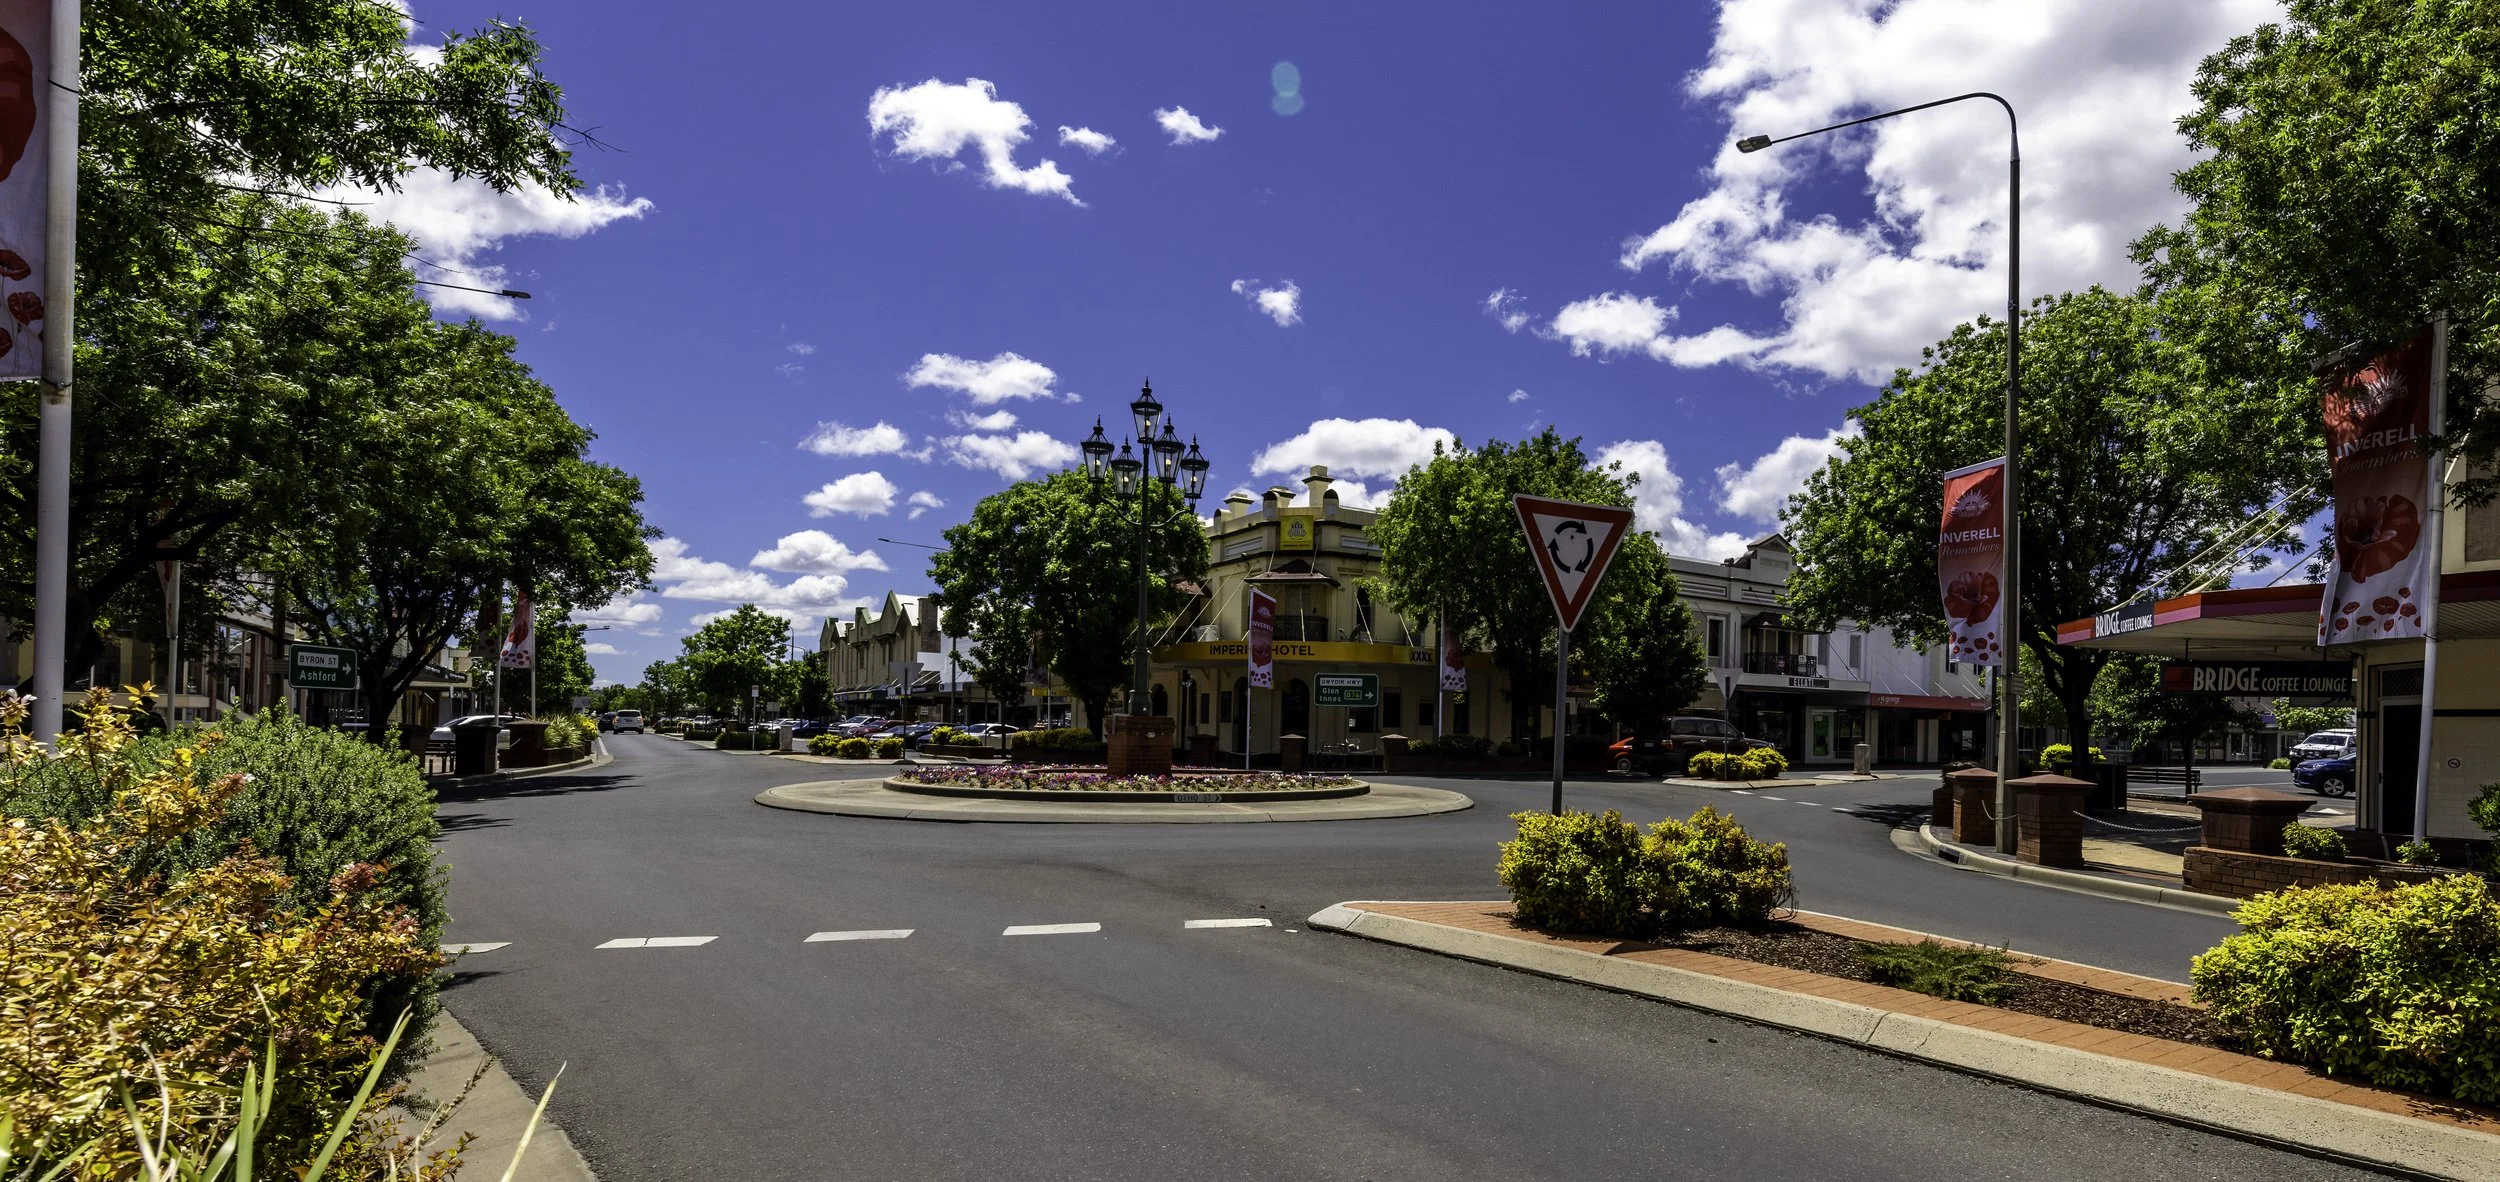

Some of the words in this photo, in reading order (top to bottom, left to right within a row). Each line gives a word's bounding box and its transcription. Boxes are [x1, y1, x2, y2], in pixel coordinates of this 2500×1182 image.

[2336, 424, 2421, 459] INVERELL
[1940, 527, 2000, 543] INVERELL
[1942, 541, 2000, 556] Remembers
[2095, 611, 2120, 638] BRIDGE
[2120, 618, 2134, 633] COFFEE
[2134, 614, 2153, 630] LOUNGE
[1209, 644, 1248, 656] IMPERI
[1272, 644, 1315, 656] HOTEL
[1409, 650, 1433, 663] XXXX
[300, 655, 325, 664] BYRON
[328, 657, 336, 665] ST
[300, 669, 336, 681] Ashford
[2193, 667, 2261, 692] BRIDGE
[2262, 677, 2300, 692] COFFEE
[2303, 677, 2348, 692] LOUNGE
[1322, 687, 1340, 695] Glen
